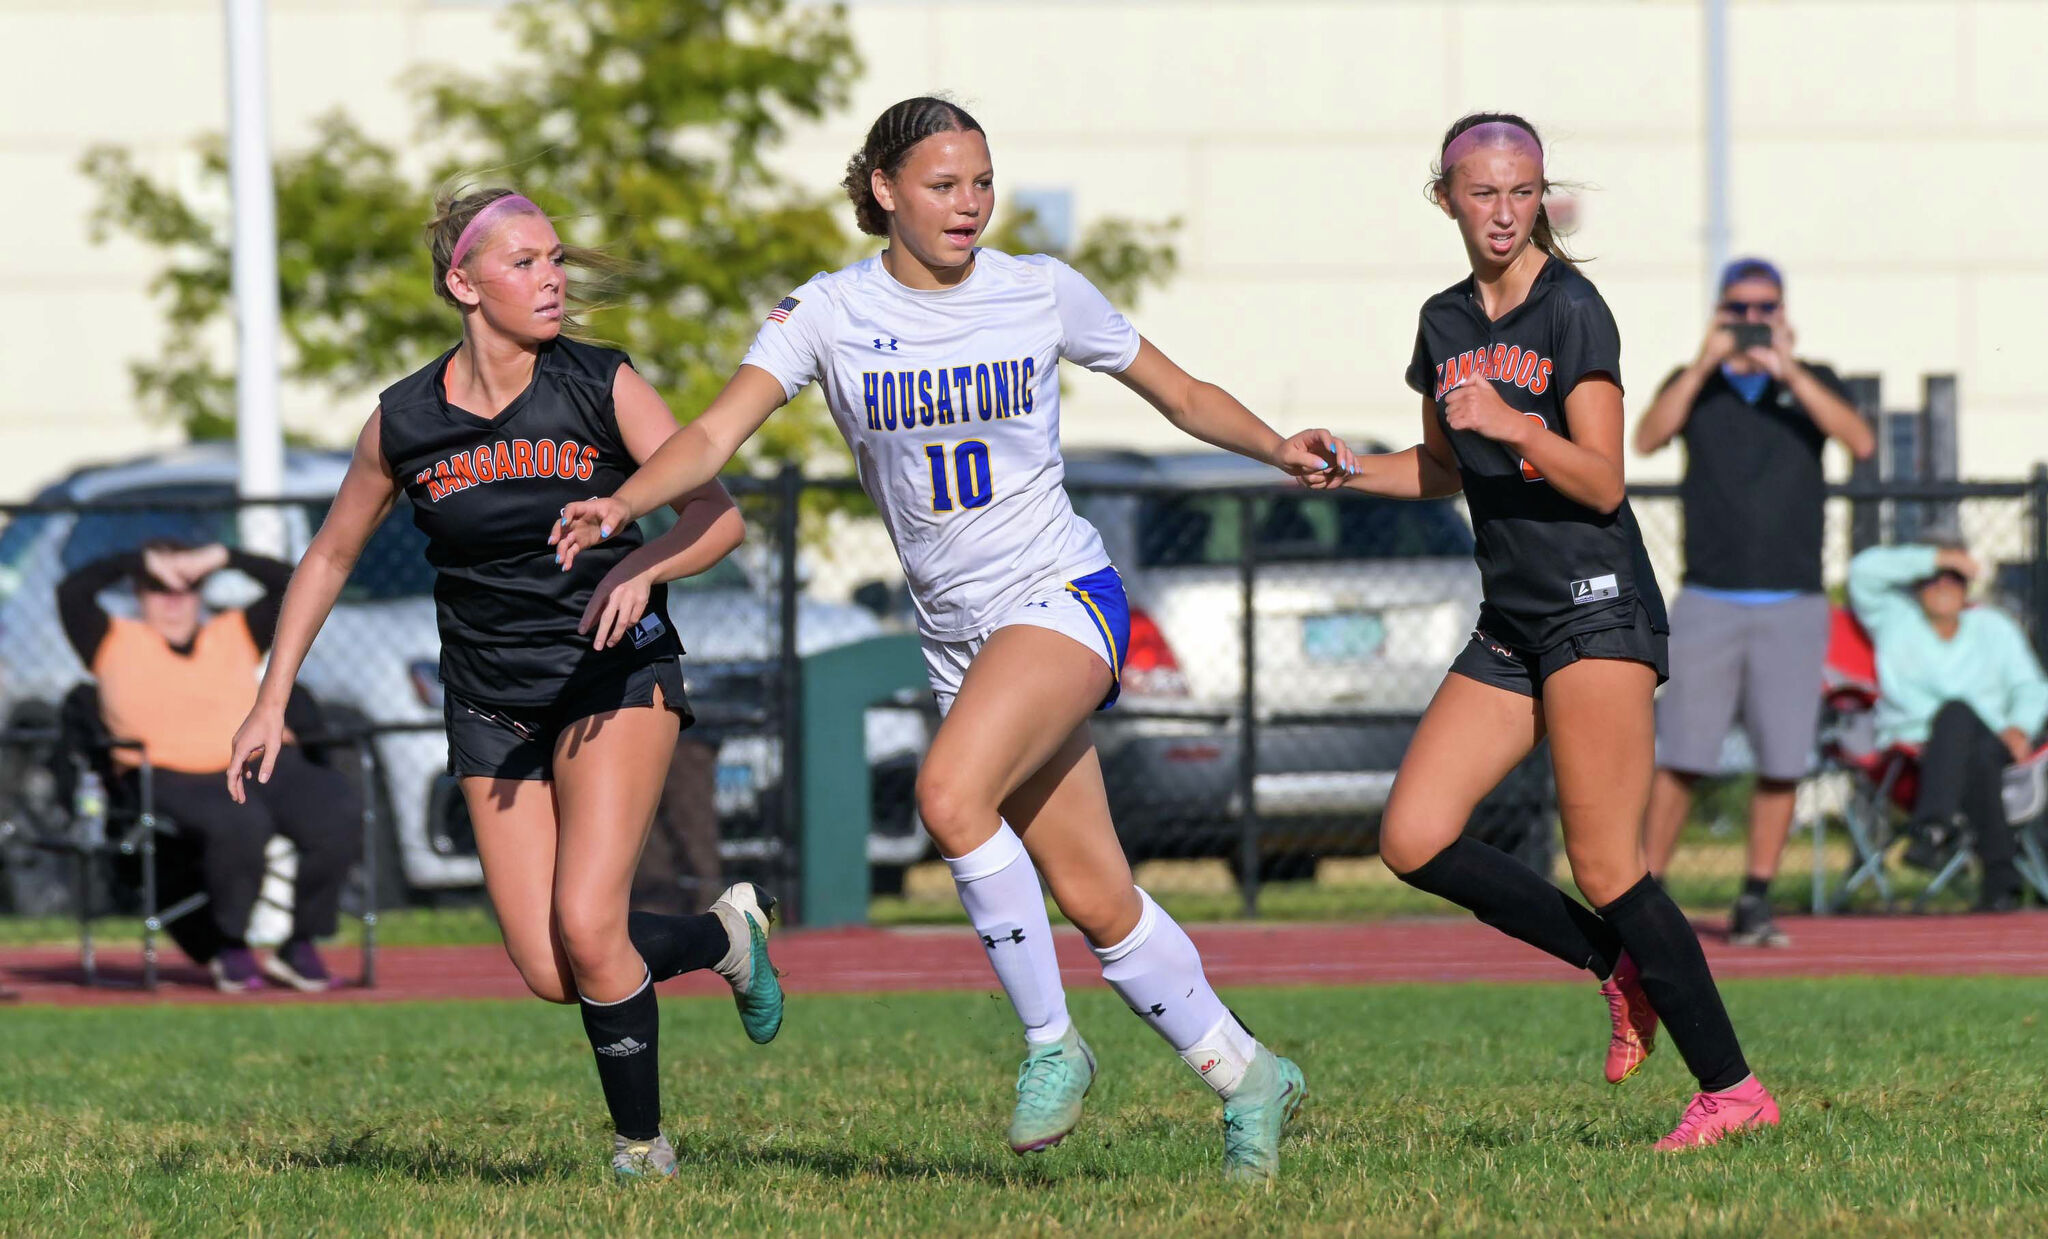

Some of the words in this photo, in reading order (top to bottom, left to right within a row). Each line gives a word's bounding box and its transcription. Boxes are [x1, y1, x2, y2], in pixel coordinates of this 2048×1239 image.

[863, 357, 1035, 431] HOUSATONIC
[1435, 343, 1553, 402] KANGAROOS
[417, 439, 599, 502] KANGAROOS
[924, 438, 993, 513] 10
[597, 1042, 647, 1057] adidas
